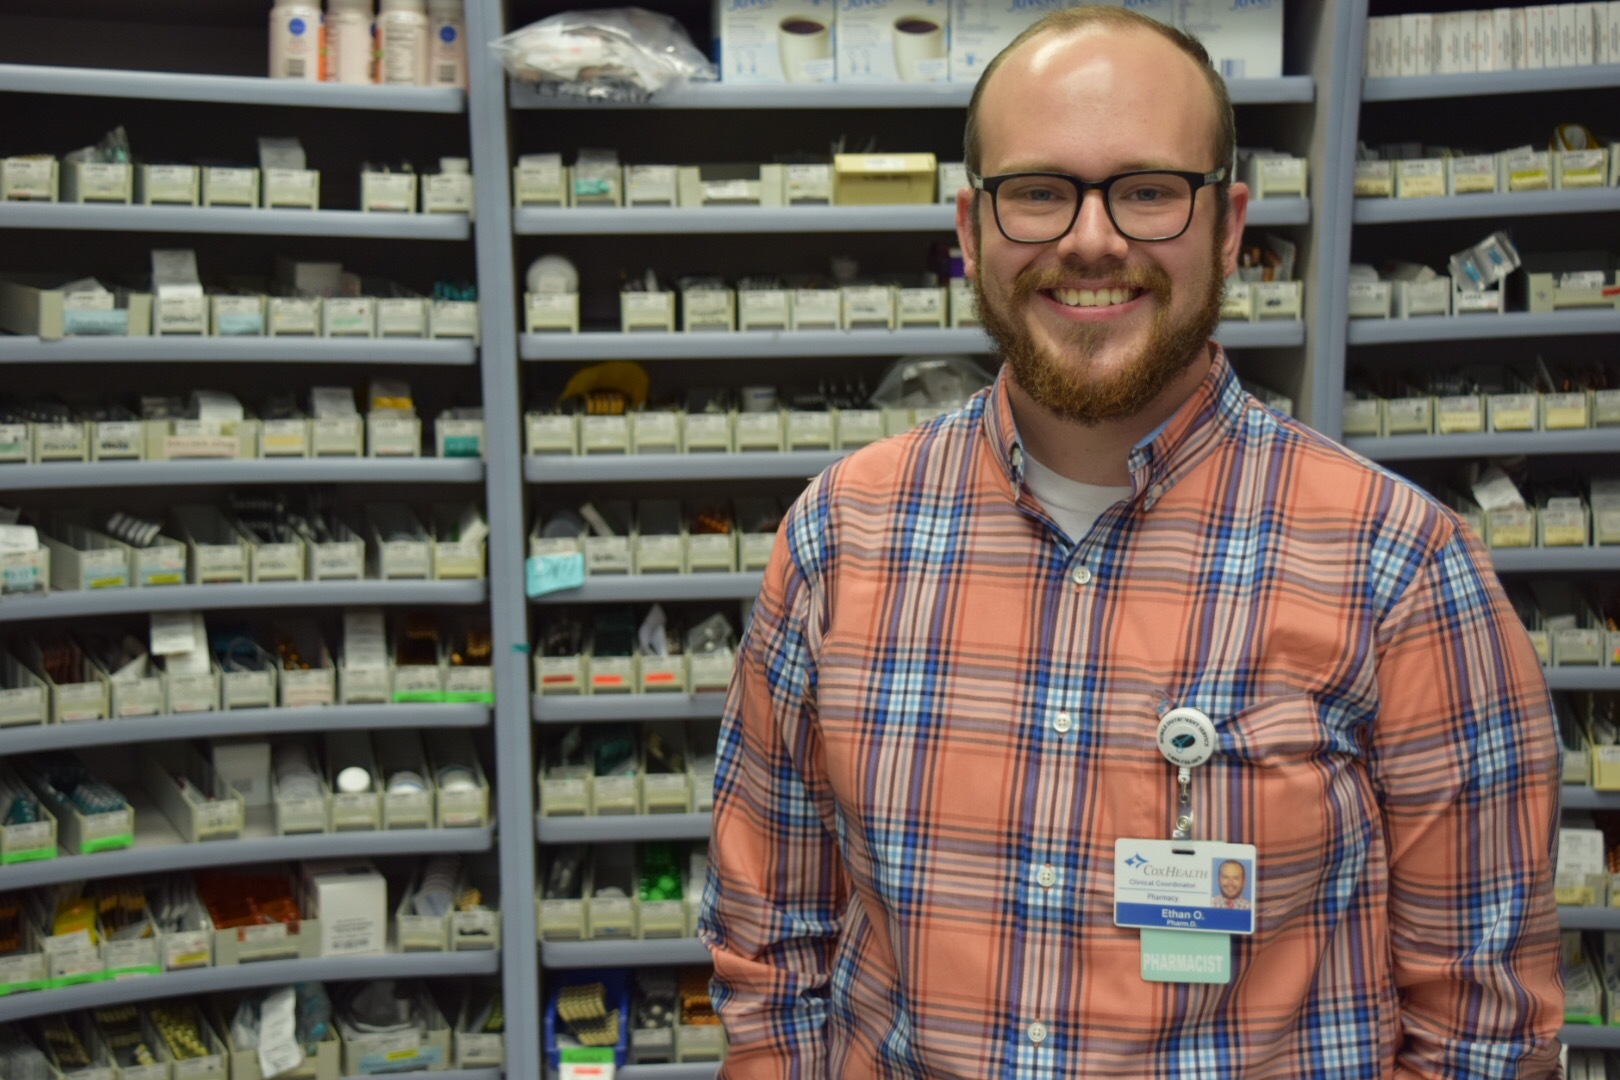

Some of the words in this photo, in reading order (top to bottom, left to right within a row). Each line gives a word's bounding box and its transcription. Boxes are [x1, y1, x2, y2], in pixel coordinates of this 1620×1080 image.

[1129, 878, 1154, 887] Clinical
[1155, 880, 1196, 888] Coordinator
[1147, 893, 1179, 903] Pharmacy
[1161, 908, 1191, 919] Ethan
[1193, 910, 1205, 920] O.
[1143, 952, 1224, 974] PHARMACIST
